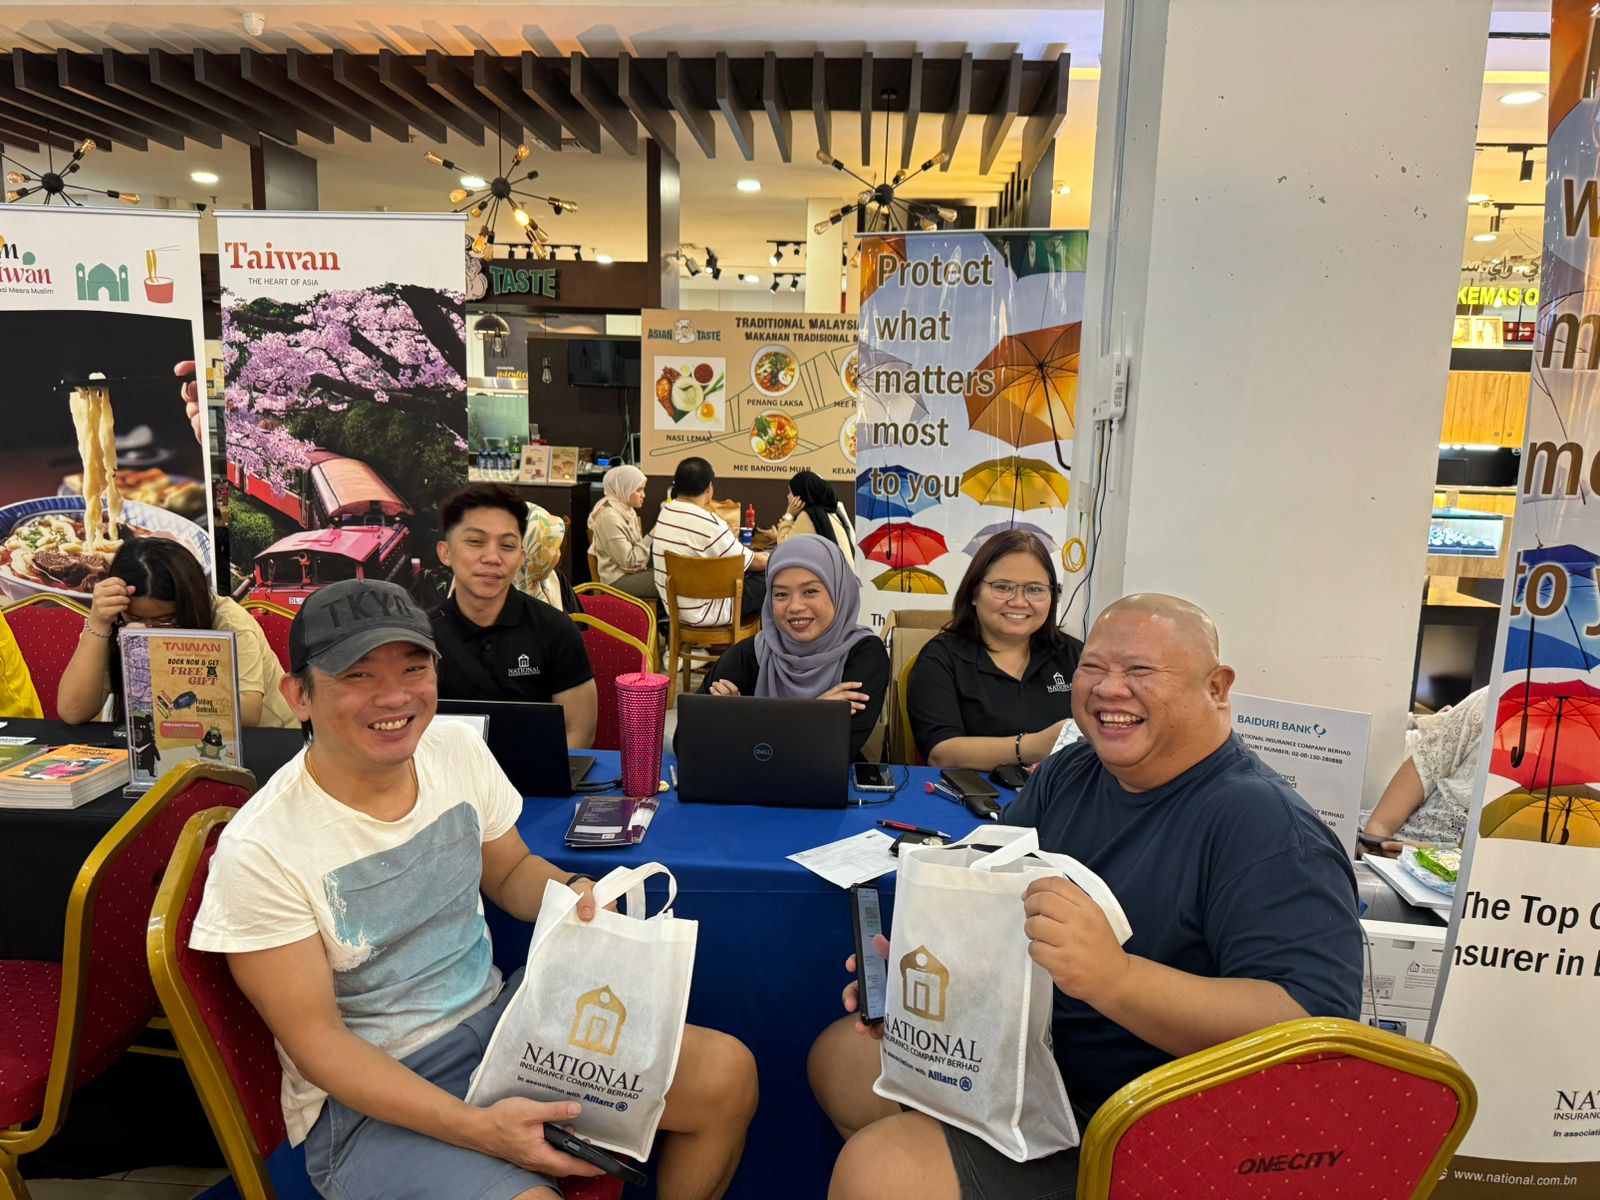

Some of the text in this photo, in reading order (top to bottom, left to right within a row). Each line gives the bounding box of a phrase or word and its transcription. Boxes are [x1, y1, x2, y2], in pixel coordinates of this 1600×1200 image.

[225, 242, 340, 271] Taiwan
[878, 254, 993, 287] Protect
[264, 278, 288, 286] HEART
[489, 266, 556, 298] TASTE
[1457, 286, 1520, 306] KEMAS
[735, 317, 805, 330] TRADITIONAL
[875, 309, 952, 342] what
[648, 329, 721, 342] ASIAN TASTE
[745, 332, 790, 342] MAKANAN
[793, 333, 849, 343] TRADISIONAL
[874, 365, 995, 396] matters
[747, 399, 804, 408] PENANG LAKSA
[686, 435, 712, 443] LEMAK
[873, 418, 949, 446] most
[750, 465, 787, 473] BANDUNG
[1524, 440, 1600, 496] m
[870, 467, 960, 502] to you
[871, 613, 886, 627] Th
[163, 642, 221, 653] TAIWAN
[171, 667, 203, 676] FREE
[188, 677, 218, 685] GIFT
[1237, 714, 1311, 734] BAIDURI BANK
[1264, 746, 1290, 756] NUMBER:
[1265, 736, 1297, 748] INSURANCE
[1297, 742, 1327, 752] COMPANY
[1328, 747, 1351, 757] BERHAD
[1321, 810, 1345, 820] BERHAD
[1461, 891, 1511, 921] The
[1521, 894, 1580, 934] Top
[1555, 947, 1585, 976] in
[522, 1041, 645, 1093] NATIONAL
[910, 1048, 947, 1065] COMPANY
[947, 1058, 980, 1073] BERHAD
[519, 1060, 640, 1101] INSURANCE COMPANY BERHAD
[928, 1069, 959, 1087] Allianz
[525, 1078, 566, 1094] association
[566, 1091, 581, 1100] with
[583, 1093, 615, 1109] Allianz
[1553, 1090, 1600, 1110] NA
[1237, 1149, 1346, 1176] ONECITY
[1454, 1169, 1578, 1186] www.national.com.bn
